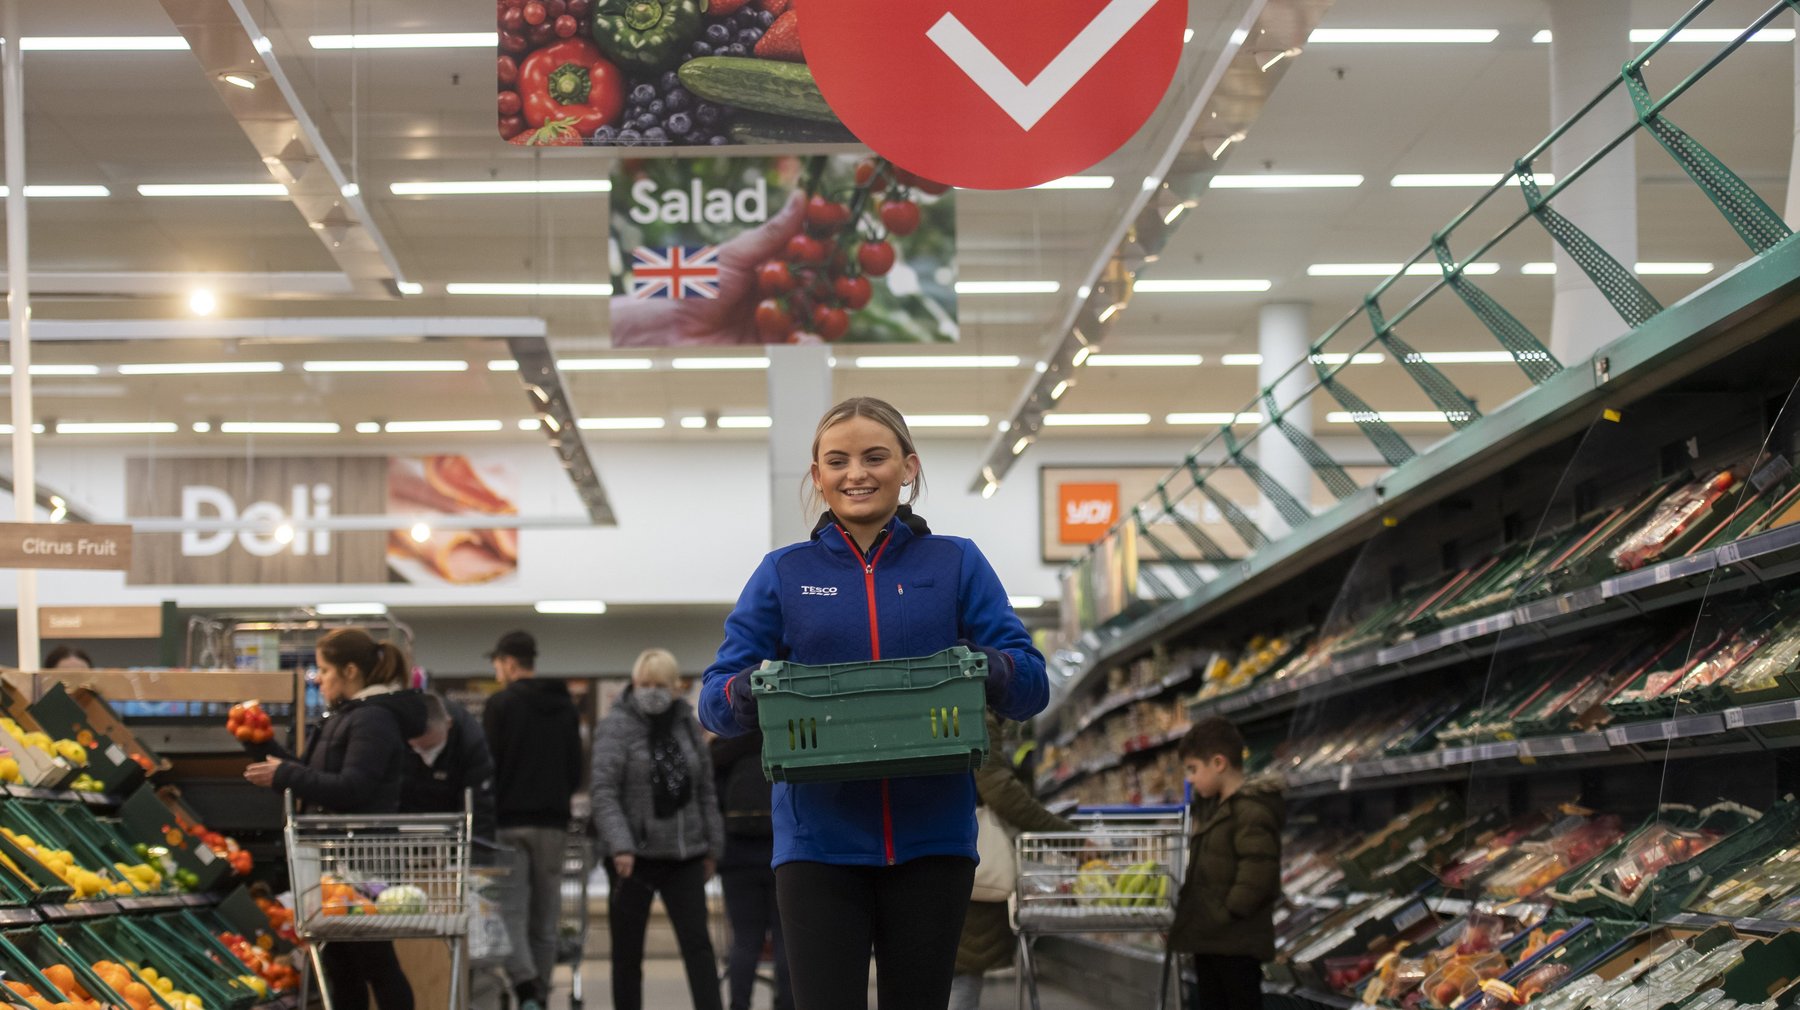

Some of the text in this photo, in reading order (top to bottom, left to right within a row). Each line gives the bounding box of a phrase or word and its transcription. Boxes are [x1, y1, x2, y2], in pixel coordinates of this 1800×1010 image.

[629, 178, 767, 224] Salad
[182, 483, 331, 556] Deli
[22, 537, 117, 556] Citrus Fruit
[801, 585, 838, 594] TESCO
